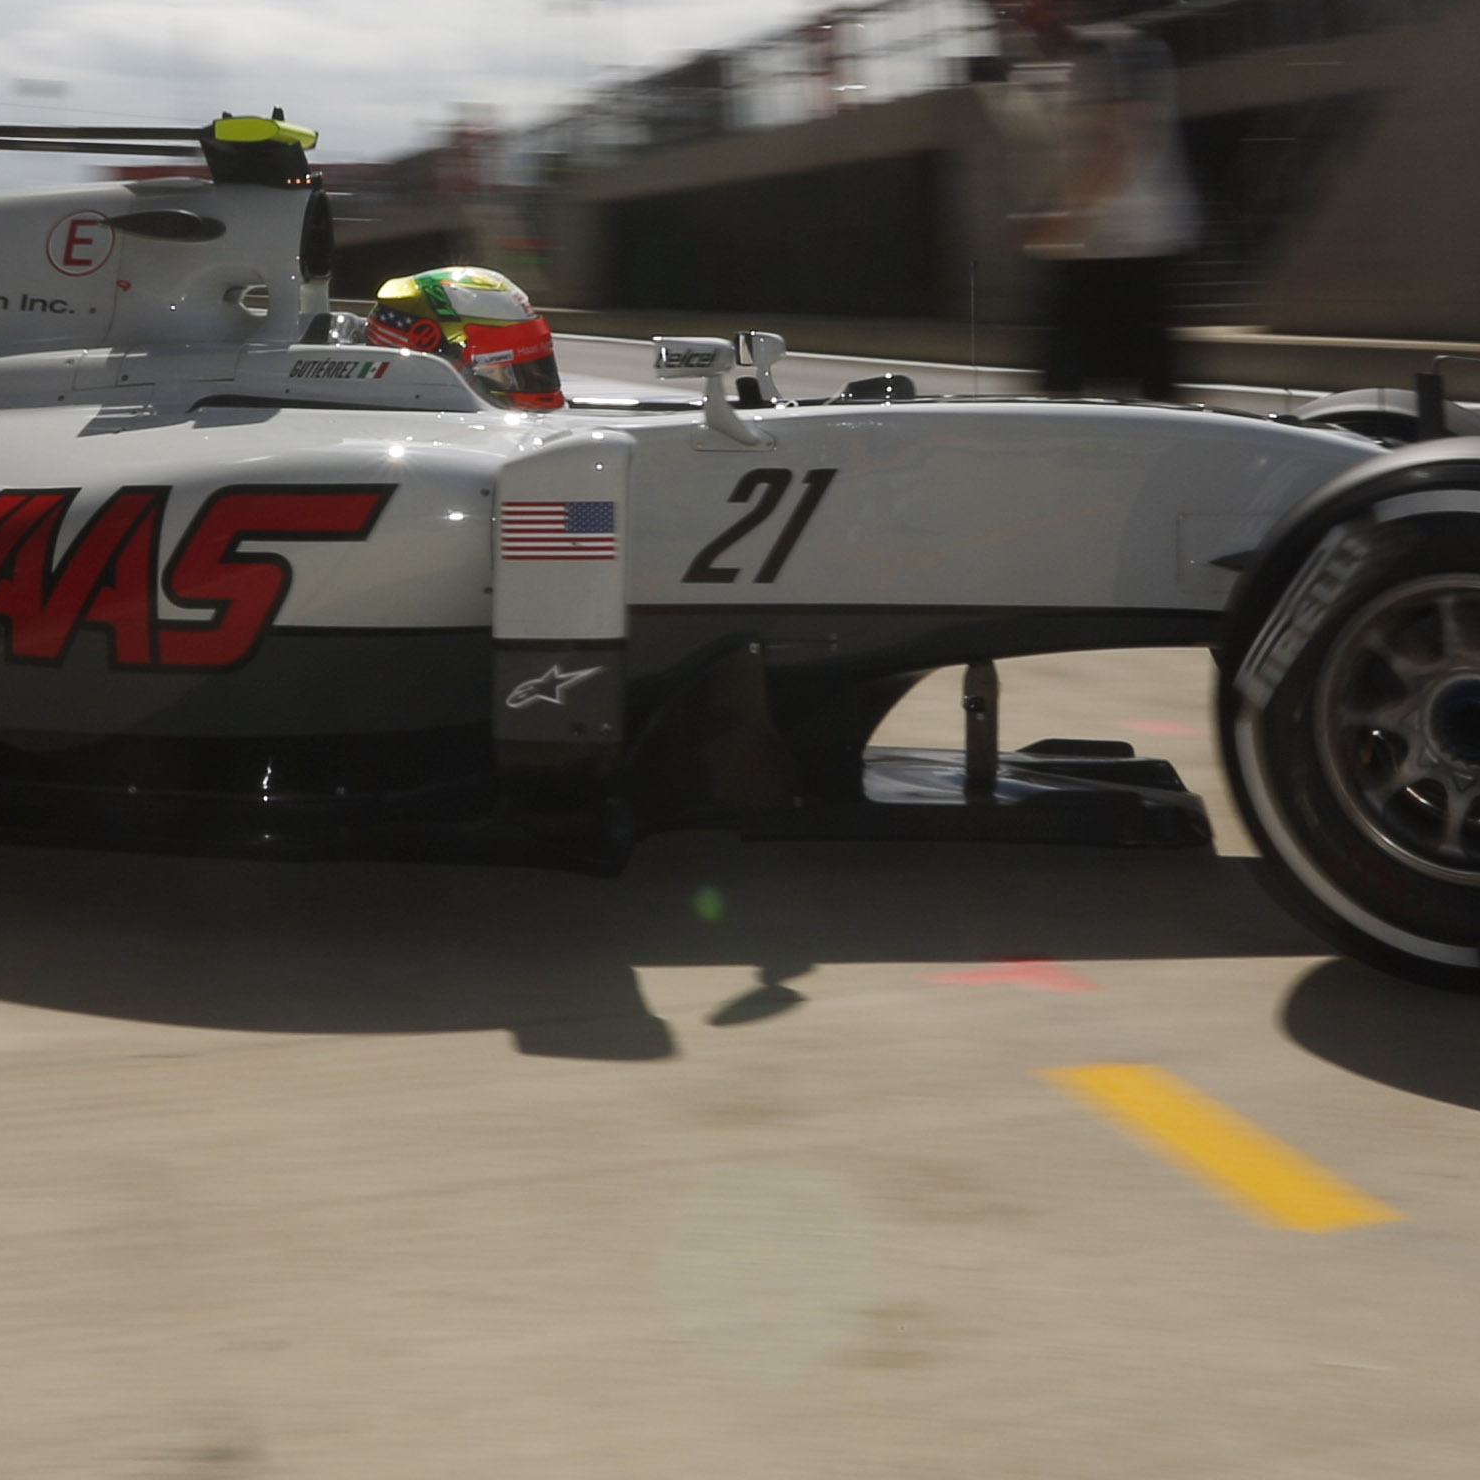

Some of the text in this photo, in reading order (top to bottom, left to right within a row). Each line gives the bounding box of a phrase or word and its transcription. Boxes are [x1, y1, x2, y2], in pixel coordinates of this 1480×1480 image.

[62, 219, 99, 267] E
[20, 293, 76, 315] Inc.
[680, 467, 839, 584] 21
